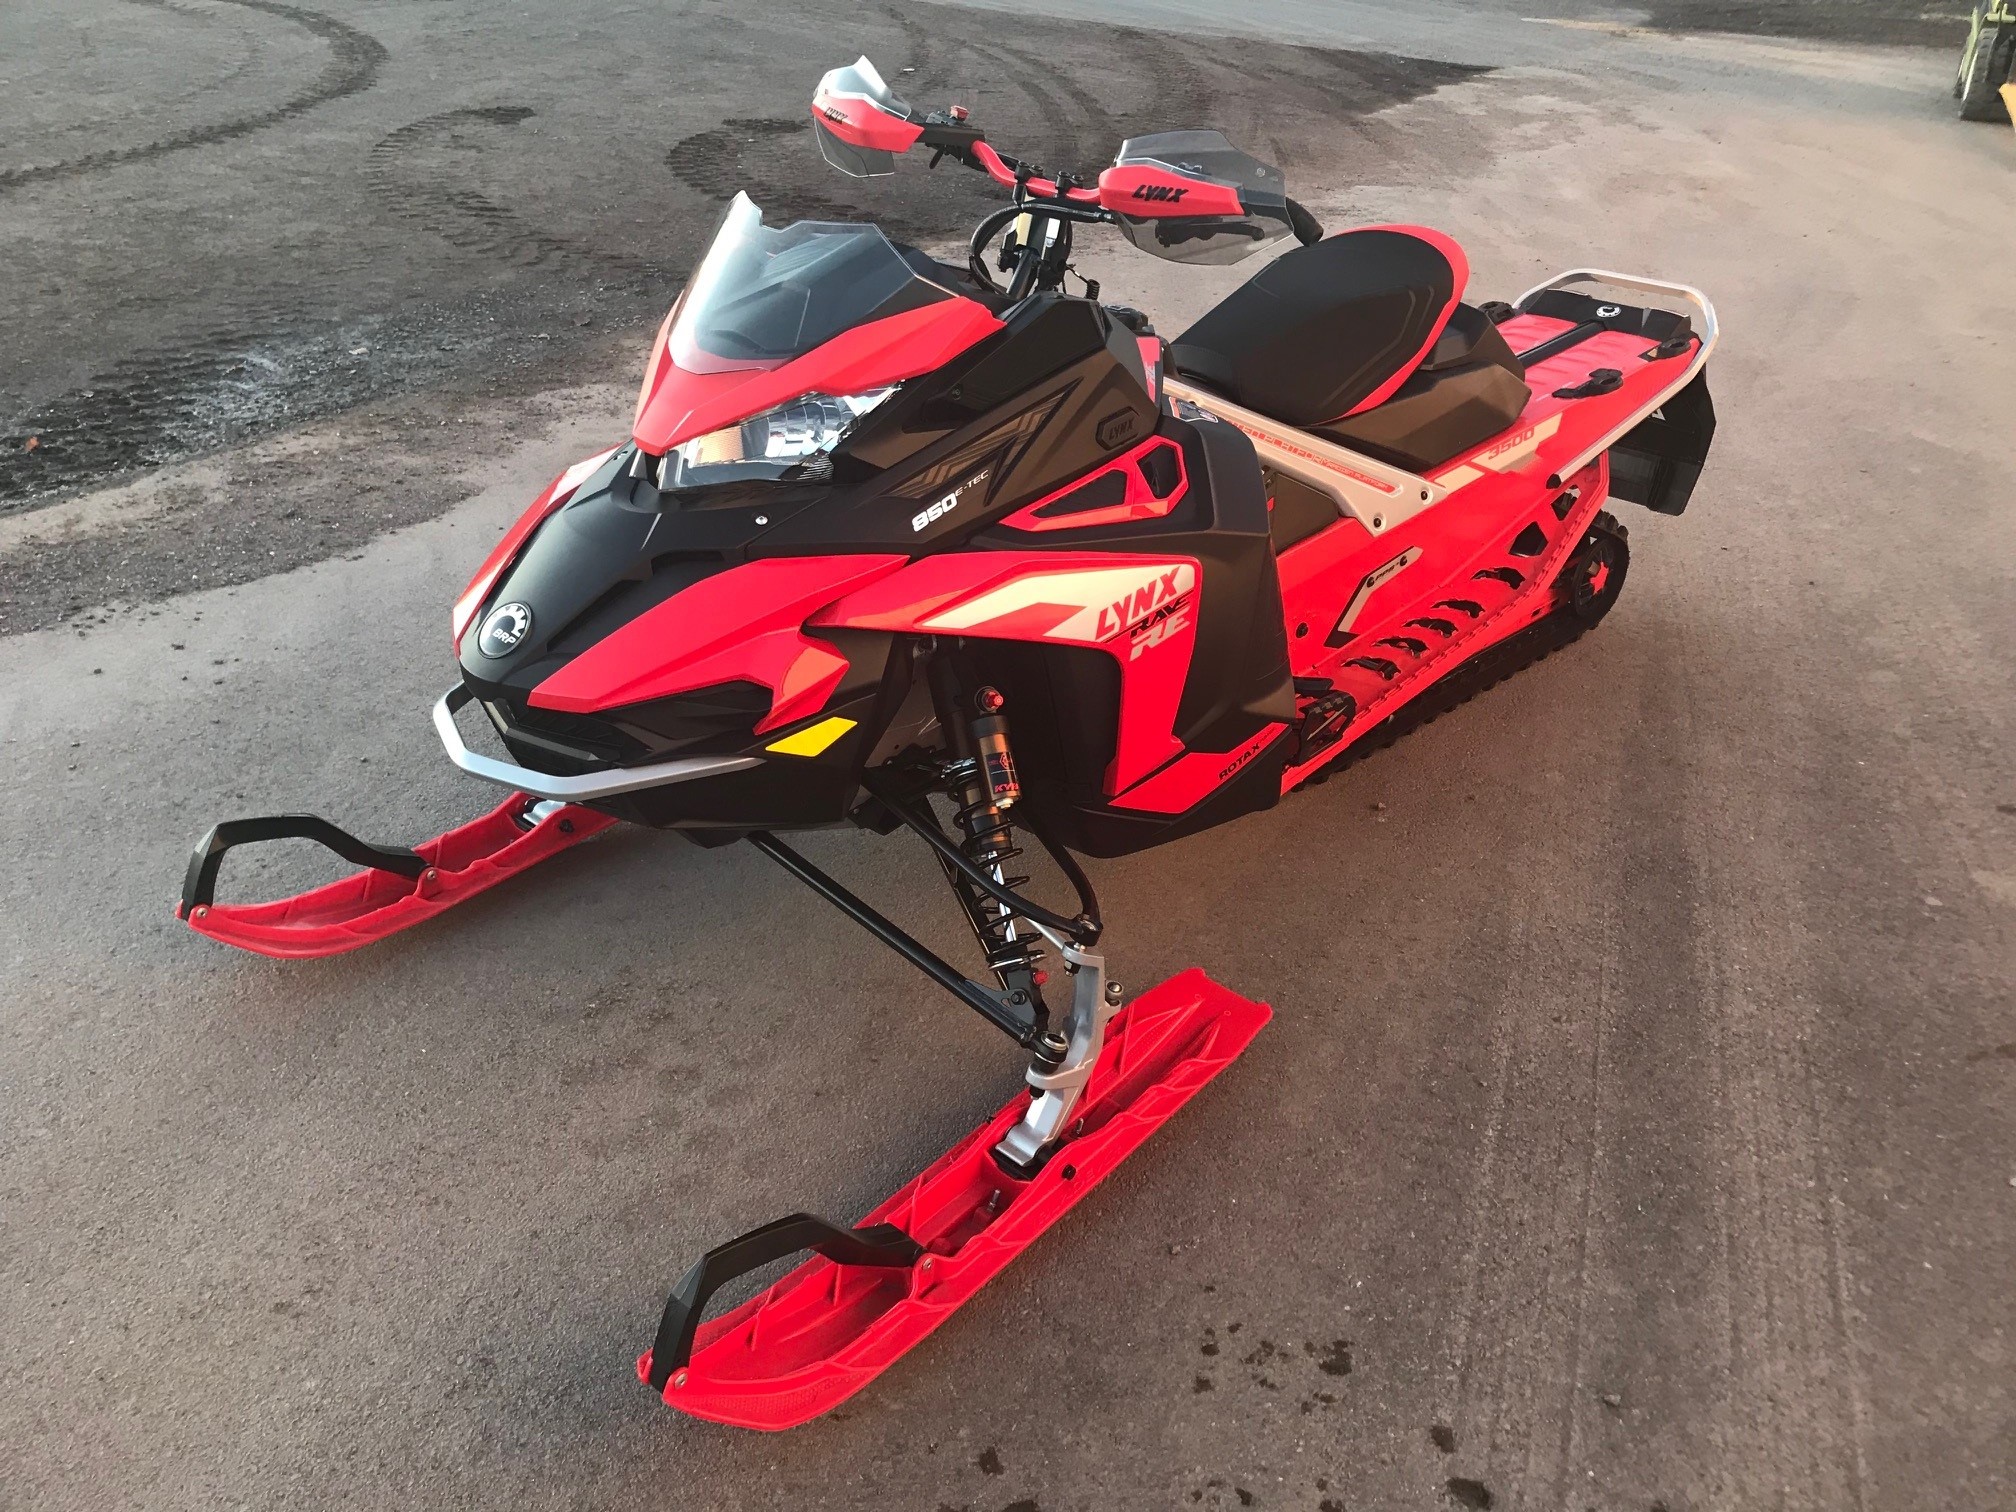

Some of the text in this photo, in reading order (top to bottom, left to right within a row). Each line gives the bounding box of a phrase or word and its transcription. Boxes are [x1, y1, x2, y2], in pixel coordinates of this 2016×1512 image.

[1131, 184, 1189, 203] LYNX
[1109, 416, 1135, 441] LYNX
[1488, 426, 1535, 460] 3500
[911, 469, 989, 532] 850 E-TEC
[1094, 565, 1181, 641] LYNX
[492, 627, 517, 644] BRP
[1129, 605, 1191, 662] RE
[1218, 743, 1260, 780] ROTAX
